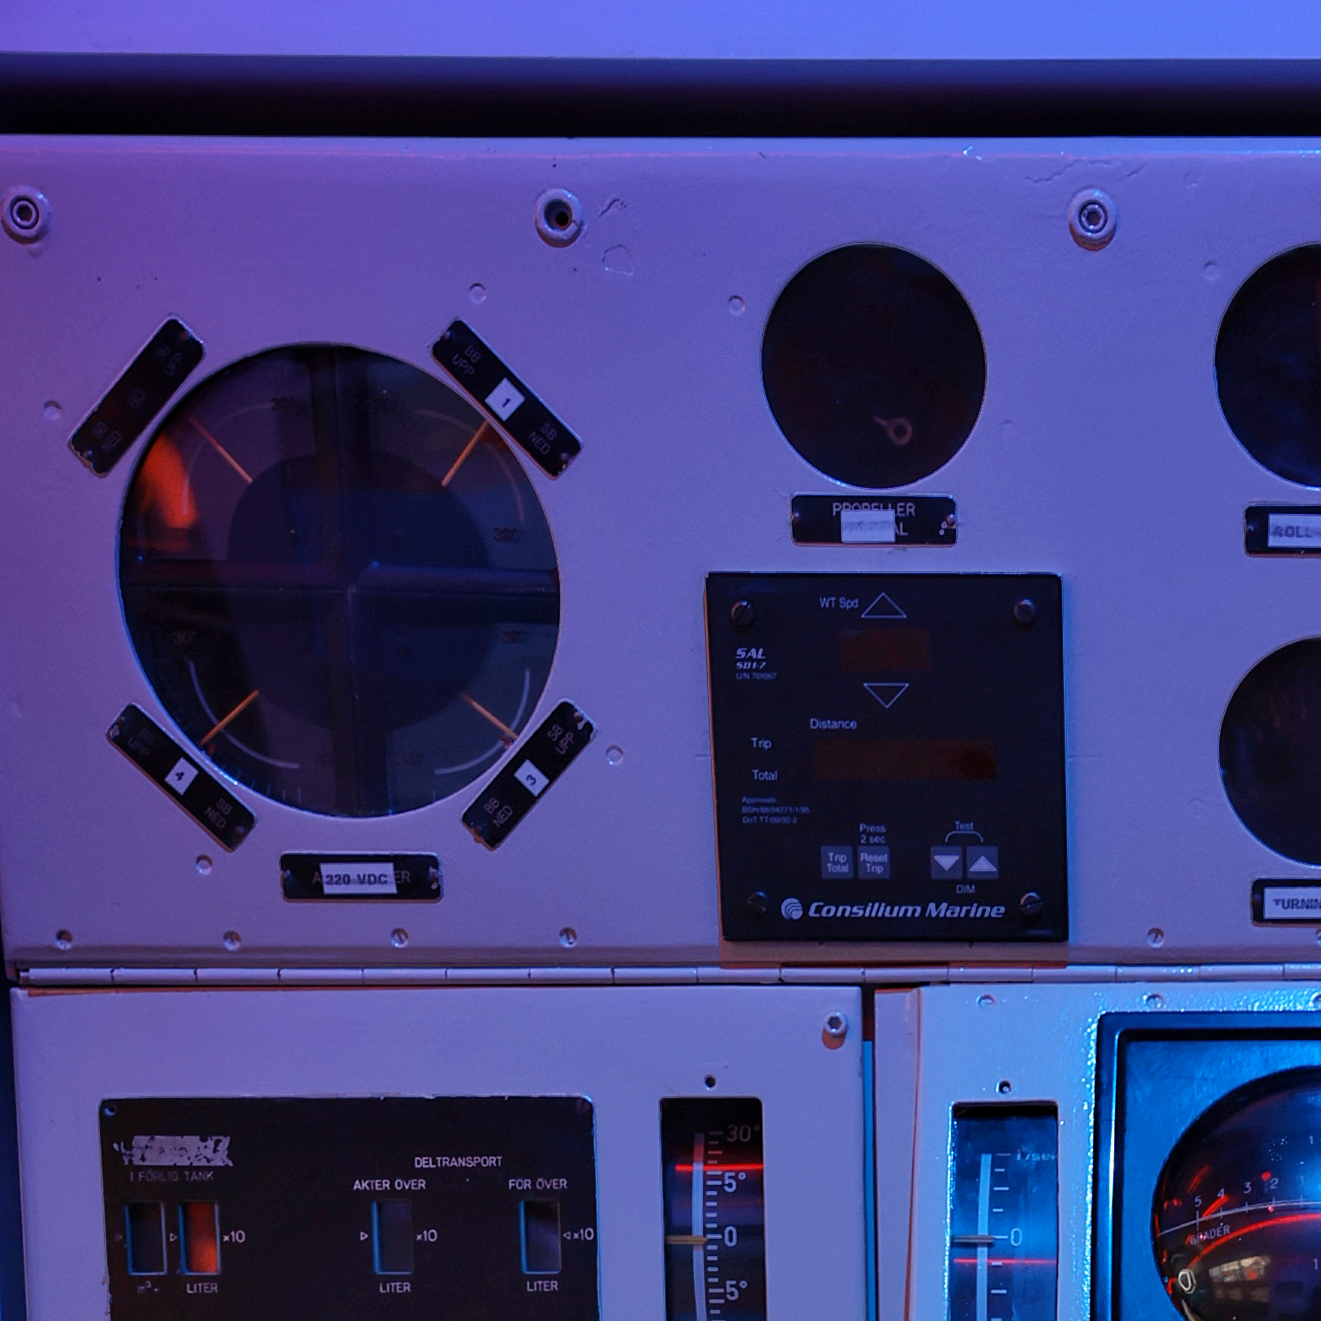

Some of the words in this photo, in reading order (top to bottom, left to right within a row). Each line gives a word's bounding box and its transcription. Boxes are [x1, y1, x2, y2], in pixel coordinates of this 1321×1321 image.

[839, 597, 859, 611] Spd
[735, 648, 766, 659] SAL
[810, 718, 857, 731] Distance
[751, 737, 772, 750] Trip
[752, 770, 778, 781] Total
[859, 823, 886, 834] Press
[954, 821, 974, 831] Test
[827, 853, 847, 864] Trip
[860, 853, 888, 863] Reset
[826, 863, 849, 874] Total
[865, 863, 884, 874] Trip
[325, 874, 350, 886] 220
[357, 873, 388, 886] VDC
[956, 885, 975, 895] DIM
[808, 902, 921, 918] Consilium
[925, 902, 1006, 918] Marine
[414, 1155, 503, 1169] DELTRANSPORT
[185, 1171, 214, 1182] TANK
[353, 1179, 390, 1191] AKTER
[724, 1225, 738, 1247] 0
[1010, 1228, 1023, 1247] 0
[186, 1283, 218, 1294] LITER
[379, 1282, 411, 1293] LITER
[526, 1280, 559, 1292] LITER
